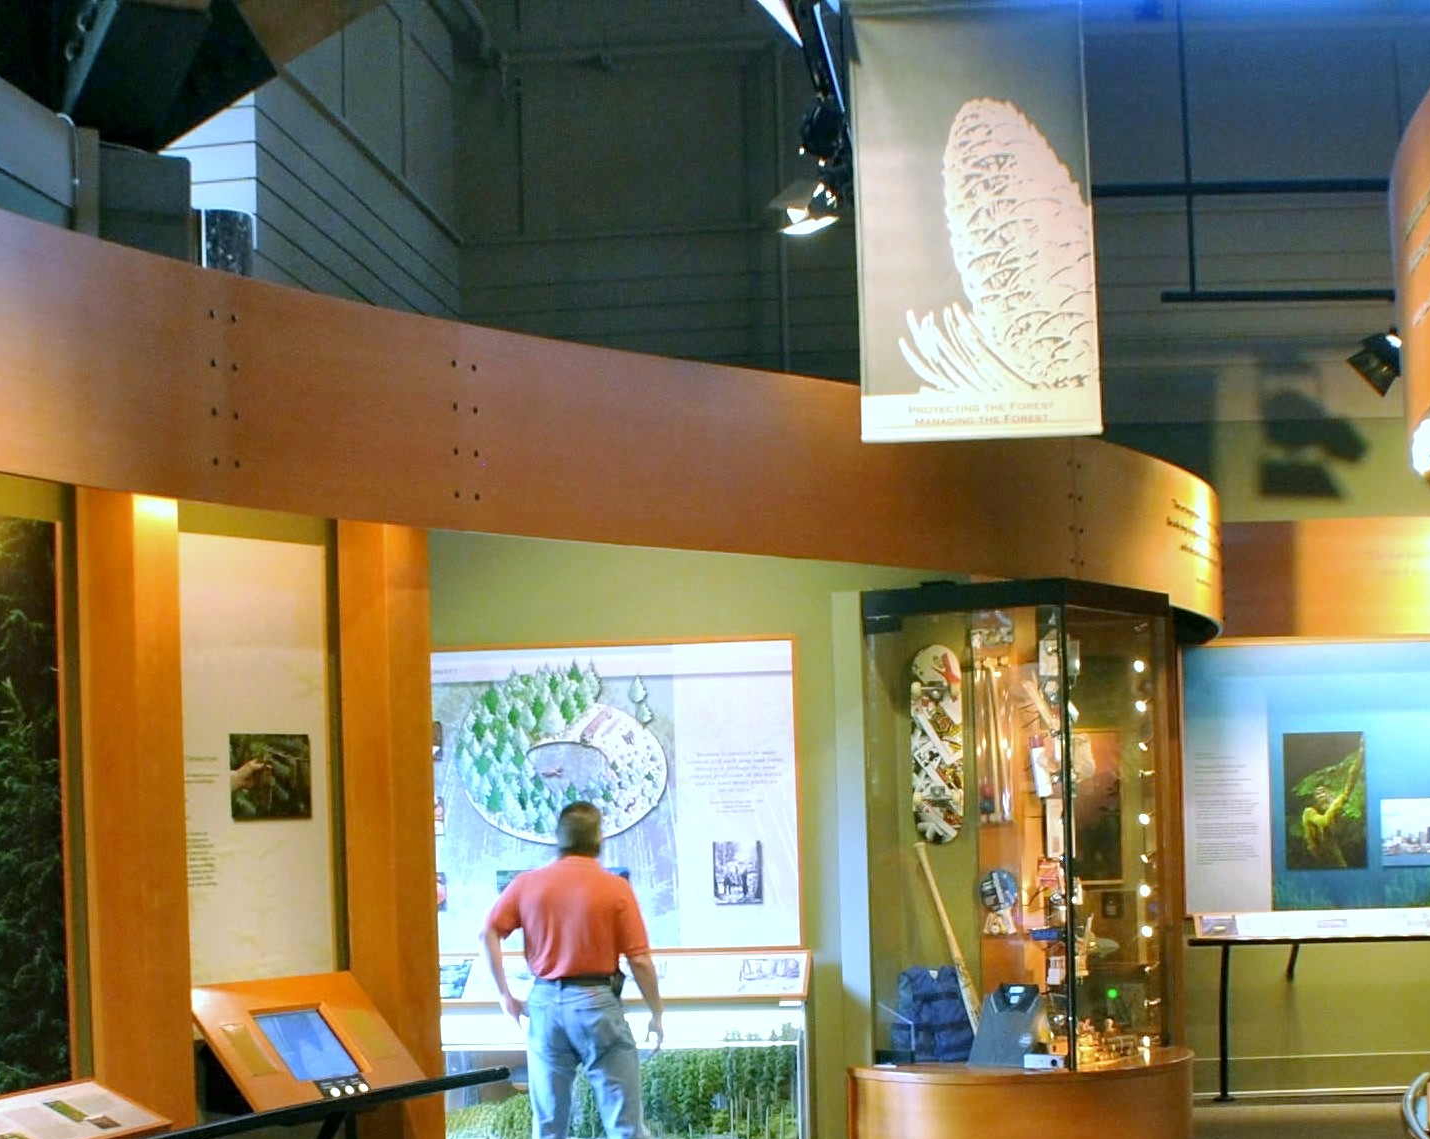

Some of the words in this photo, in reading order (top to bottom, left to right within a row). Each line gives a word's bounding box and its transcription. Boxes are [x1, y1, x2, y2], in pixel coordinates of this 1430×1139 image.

[984, 403, 1006, 413] THE
[1009, 401, 1055, 411] FOREST
[978, 415, 1000, 424] THE
[1004, 414, 1049, 424] FOREST
